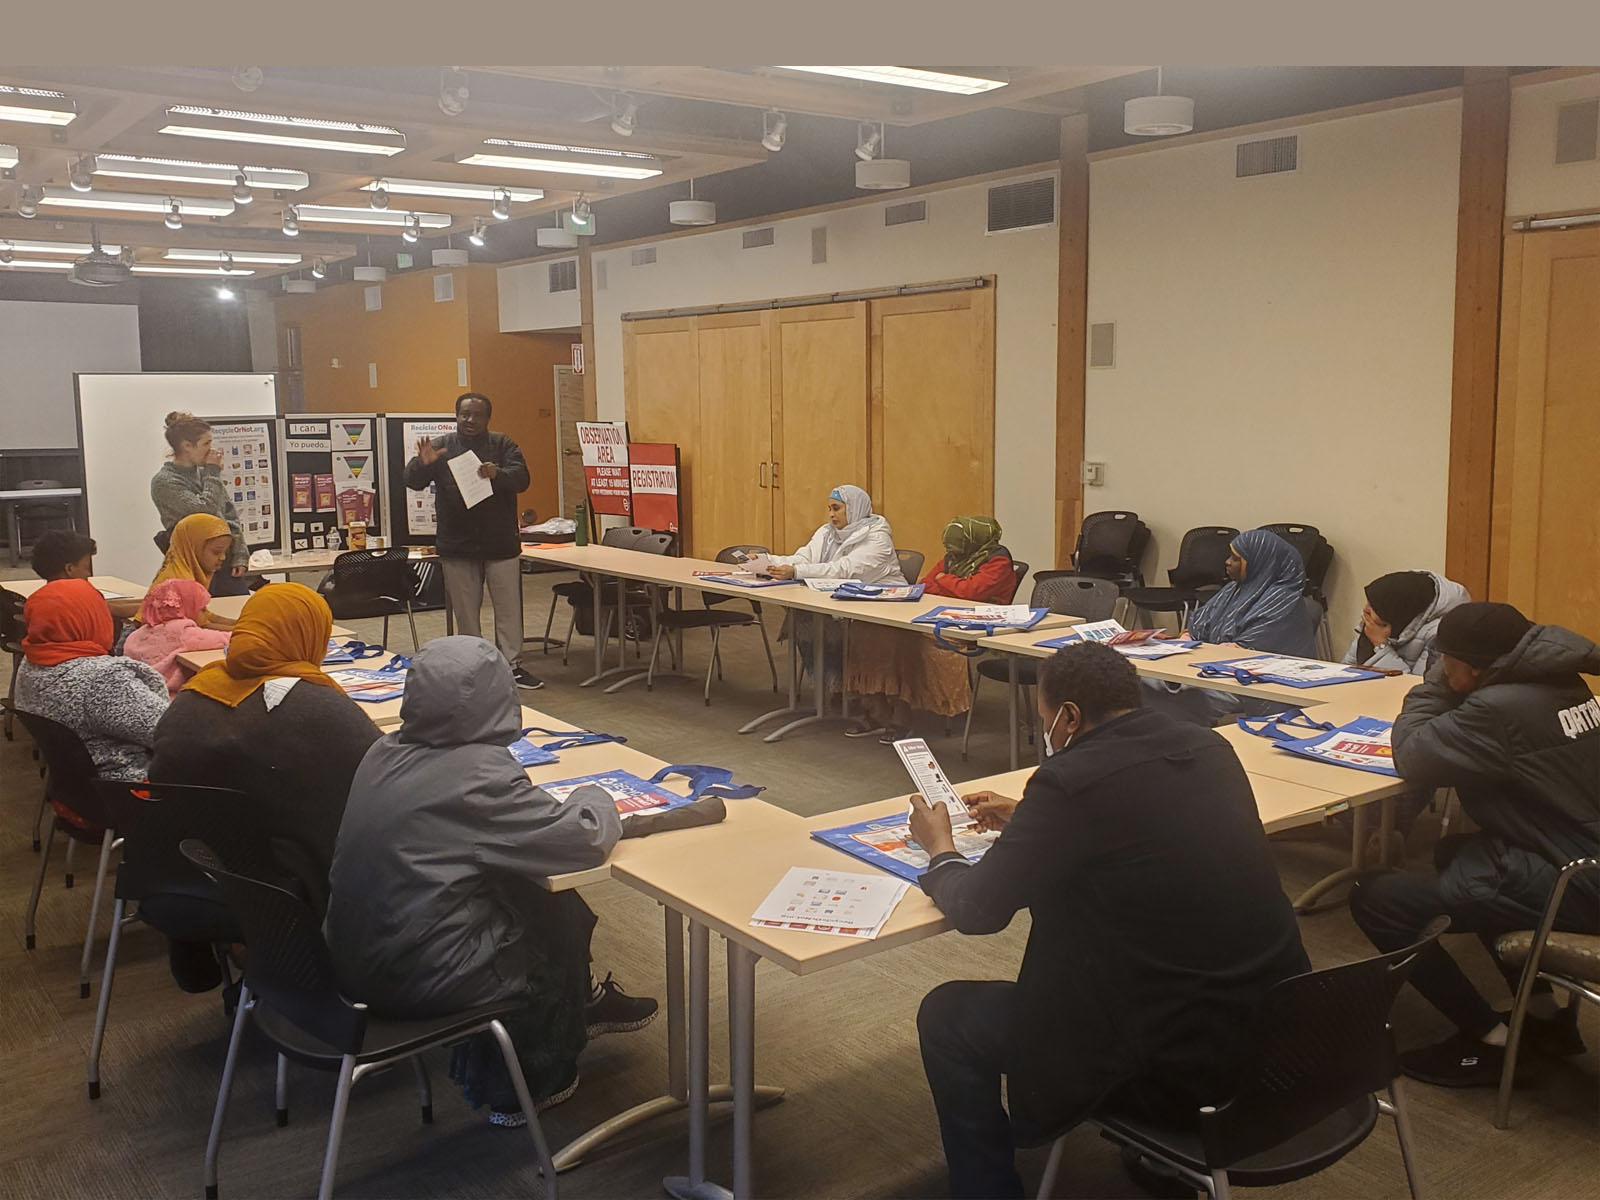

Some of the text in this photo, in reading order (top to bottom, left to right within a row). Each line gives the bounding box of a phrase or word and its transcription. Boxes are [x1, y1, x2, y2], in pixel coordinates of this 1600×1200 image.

[300, 425, 316, 433] can
[580, 426, 624, 445] OBSERVATION
[597, 446, 615, 464] AREA
[596, 467, 612, 476] PLEASE
[632, 470, 676, 489] REGISTRATION
